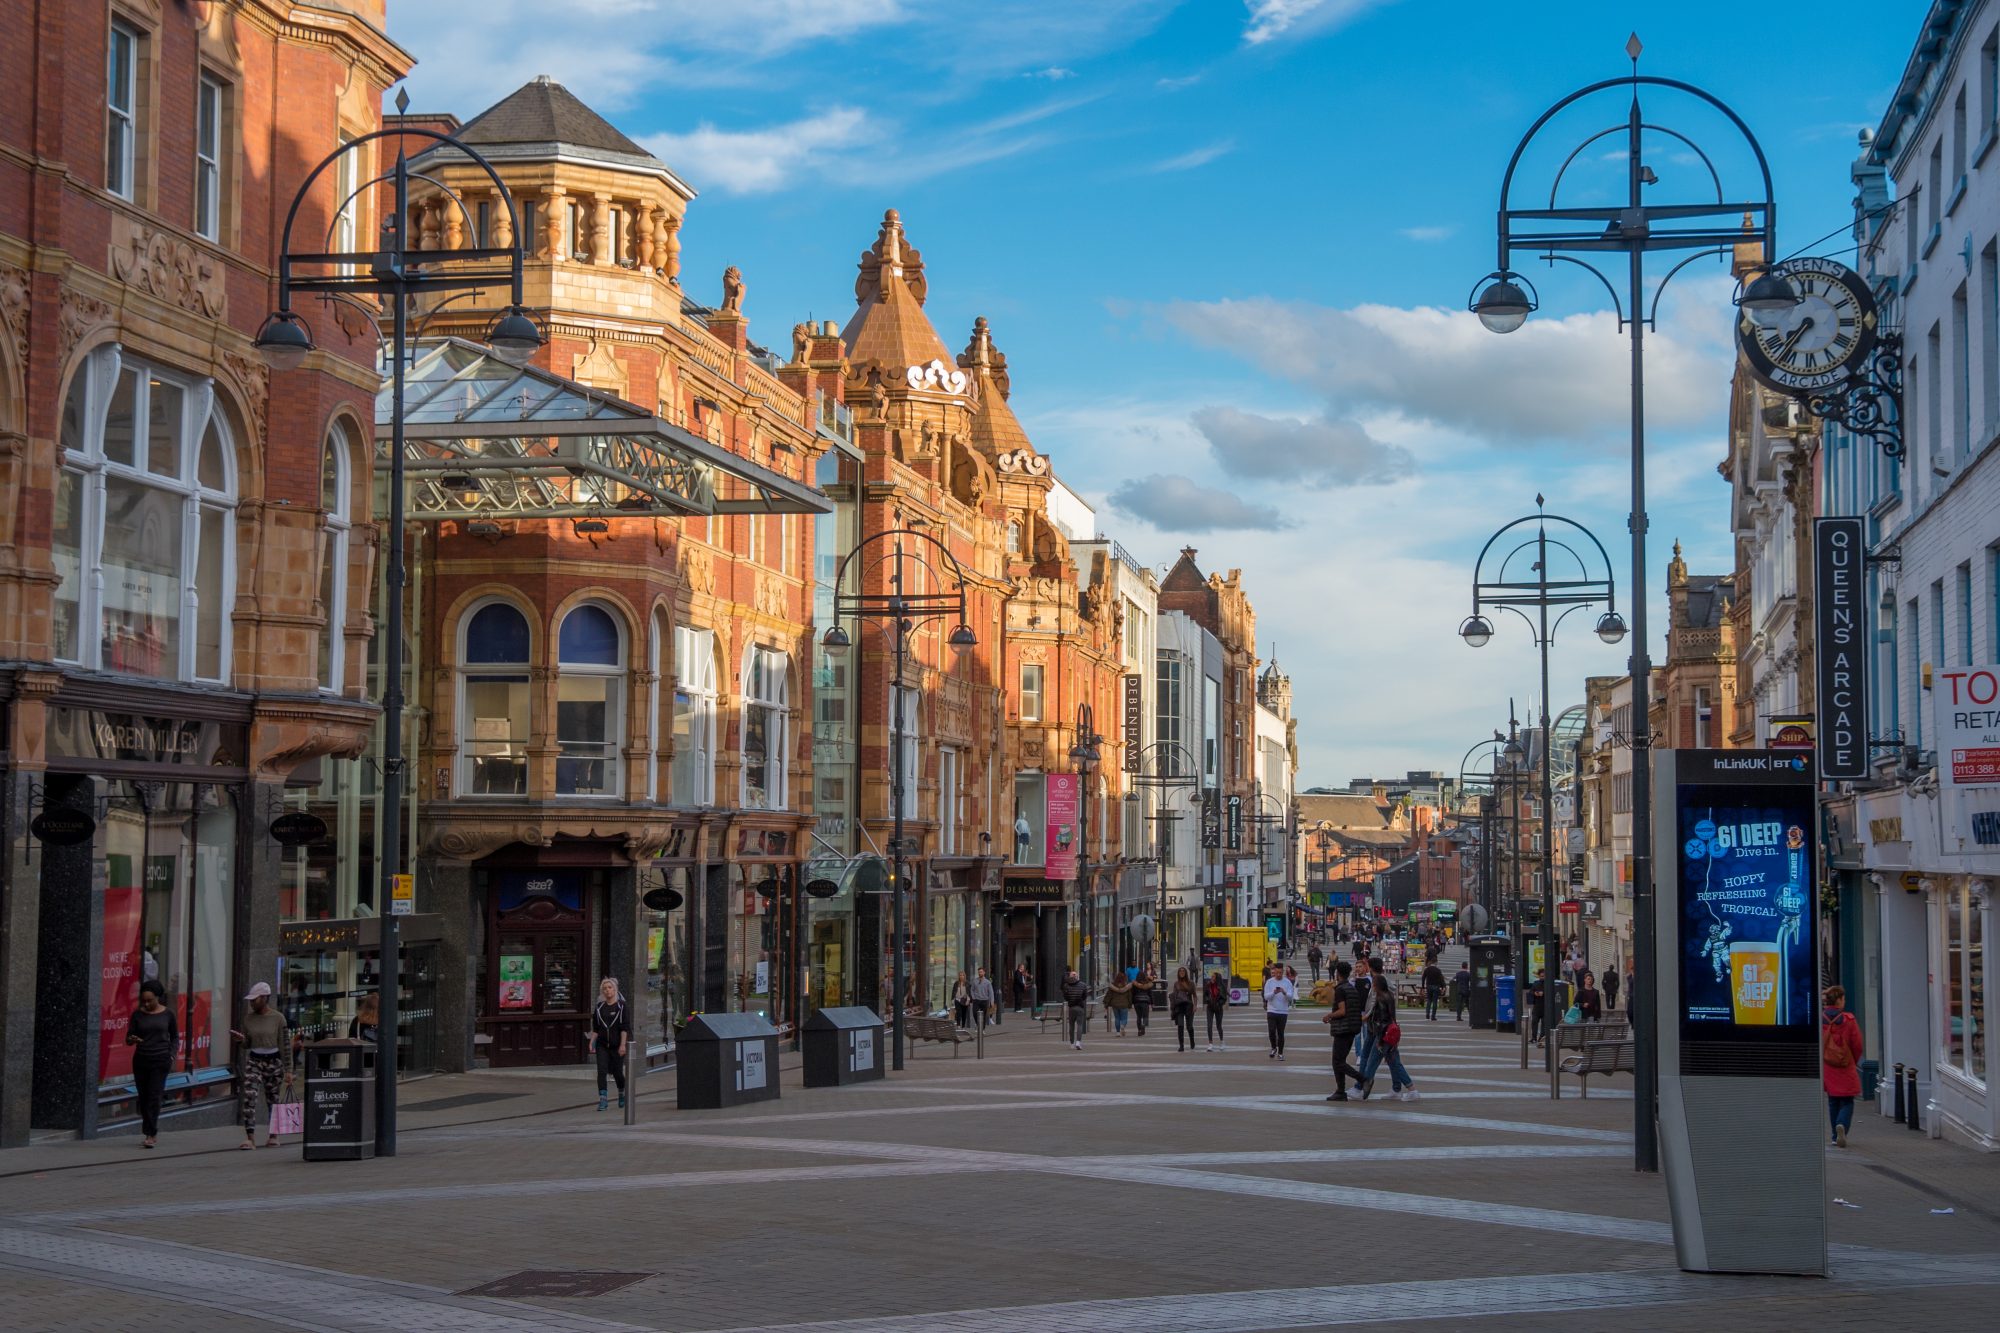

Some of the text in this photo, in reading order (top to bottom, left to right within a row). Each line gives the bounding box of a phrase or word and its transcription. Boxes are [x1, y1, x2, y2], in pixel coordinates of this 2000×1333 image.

[1779, 259, 1842, 277] UEEN'S
[1779, 370, 1840, 388] ARCADE
[1831, 530, 1853, 767] QUEEN'S ARCADE
[1128, 678, 1138, 769] DEBENHAMS
[95, 723, 199, 755] KAREN MILLEN
[1781, 733, 1804, 742] SHIP
[1714, 758, 1791, 769] InLinkUK BT
[1953, 765, 1975, 775] 0113
[1976, 764, 1996, 774] 388
[1229, 796, 1240, 805] JD
[1718, 822, 1782, 848] 61 DEEP
[1735, 846, 1780, 858] Dive in.
[526, 878, 553, 891] size?
[1724, 872, 1766, 888] HOPPY
[1006, 884, 1061, 894] DEBENHAMS
[1697, 888, 1767, 901] REFRESHING
[1783, 887, 1791, 897] 61
[1783, 897, 1800, 909] DEEP
[1721, 903, 1777, 917] TROPICAL
[108, 952, 129, 963] WE'RE
[103, 966, 133, 979] CLOSING!
[1743, 964, 1757, 982] 61
[1744, 982, 1773, 1001] DEEP
[197, 1036, 211, 1049] OFF
[858, 1040, 872, 1050] VICTORIA
[746, 1051, 763, 1064] VICTORIA
[321, 1070, 342, 1078] Litter
[325, 1091, 349, 1100] Leeds
